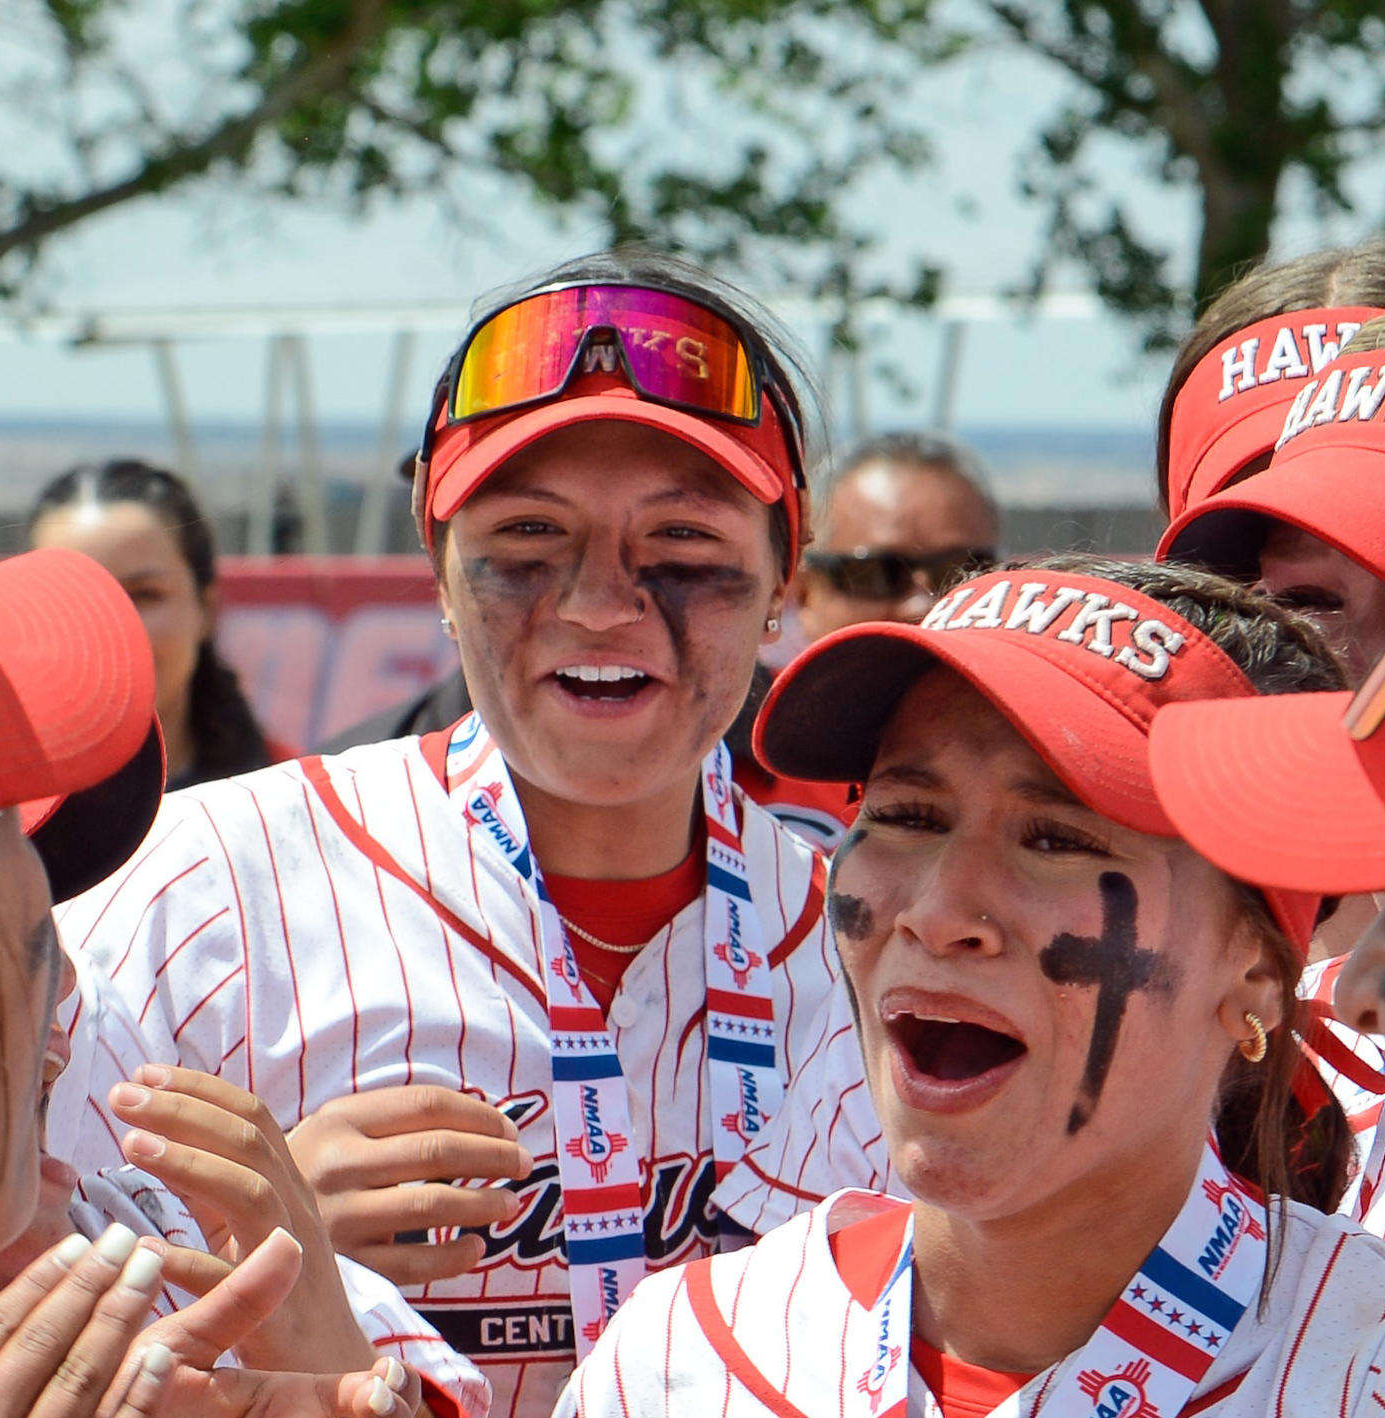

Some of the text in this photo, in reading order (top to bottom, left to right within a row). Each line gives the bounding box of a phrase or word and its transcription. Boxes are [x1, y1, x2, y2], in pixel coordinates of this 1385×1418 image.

[1217, 321, 1362, 403] HAW
[920, 580, 1186, 680] HAWKS
[471, 796, 519, 855] NMAA
[727, 897, 746, 964] NMAA
[583, 1084, 606, 1155] NMAA
[740, 1068, 761, 1133] NMAA
[1197, 1196, 1242, 1277] NMAA
